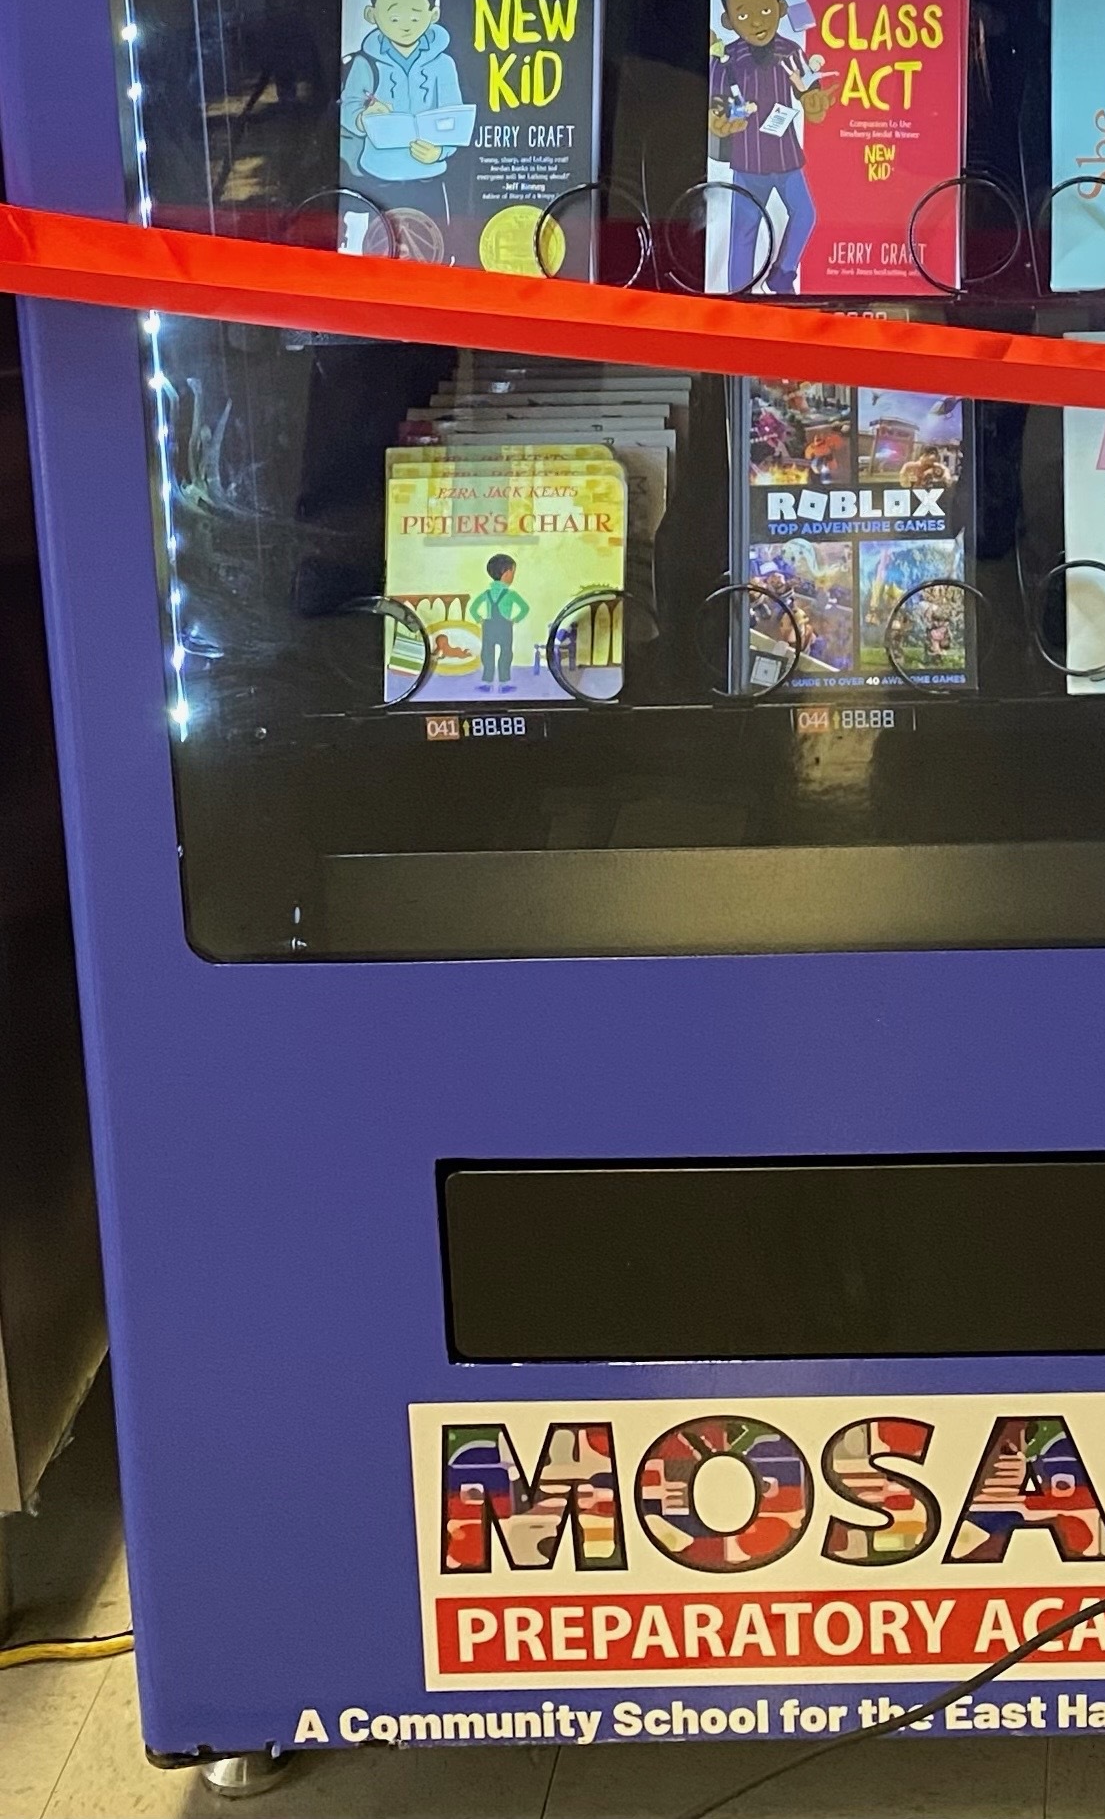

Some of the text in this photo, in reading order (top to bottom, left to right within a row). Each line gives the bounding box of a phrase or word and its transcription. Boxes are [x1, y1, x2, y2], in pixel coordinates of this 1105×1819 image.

[821, 2, 944, 52] CLASS
[488, 49, 563, 113] KiD
[840, 58, 922, 110] ACT
[889, 119, 898, 128] to
[900, 119, 912, 128] the
[474, 125, 576, 148] JERRY CRAFT
[864, 144, 896, 164] NEW
[828, 242, 872, 265] JERRY
[438, 485, 579, 499] EZRA JACK KEATS
[767, 487, 946, 521] ROBLOX
[401, 512, 615, 535] PETER'S CHAIR
[768, 519, 946, 536] TOP ADVENTURE GAMES
[426, 717, 526, 738] 041 88.88
[799, 709, 895, 728] 044 88.88
[456, 1599, 957, 1663] PREPARATORY
[294, 1709, 329, 1743] A
[338, 1701, 602, 1746] Community
[613, 1699, 769, 1737] School
[780, 1699, 848, 1733] for
[945, 1694, 1046, 1731] East
